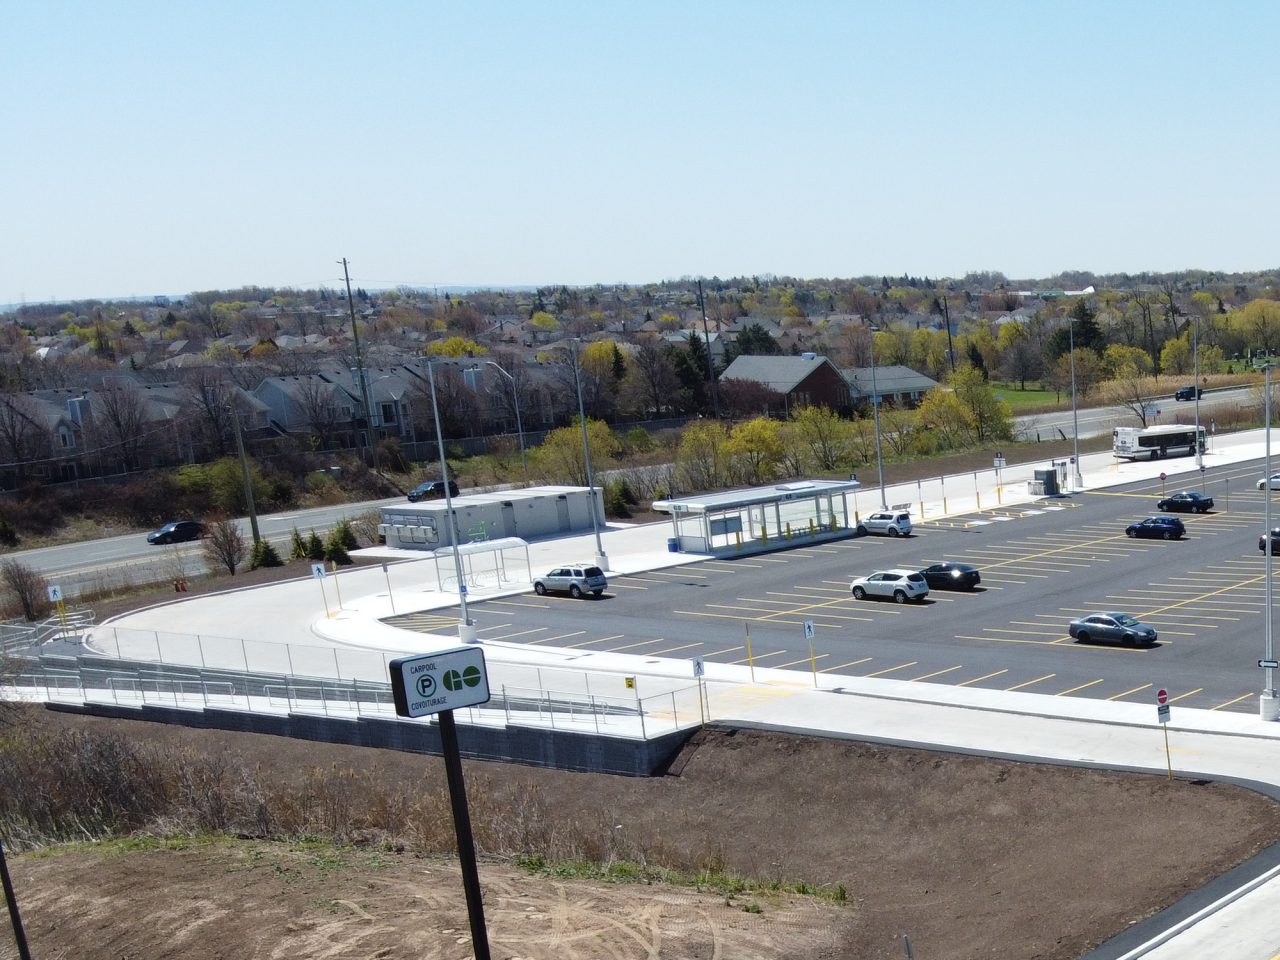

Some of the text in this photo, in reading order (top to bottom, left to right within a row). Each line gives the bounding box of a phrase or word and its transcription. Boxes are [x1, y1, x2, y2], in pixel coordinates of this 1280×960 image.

[410, 663, 437, 675] CARPOOL
[420, 678, 432, 694] P
[442, 665, 481, 692] GO
[411, 696, 448, 711] COVOITURAGE
